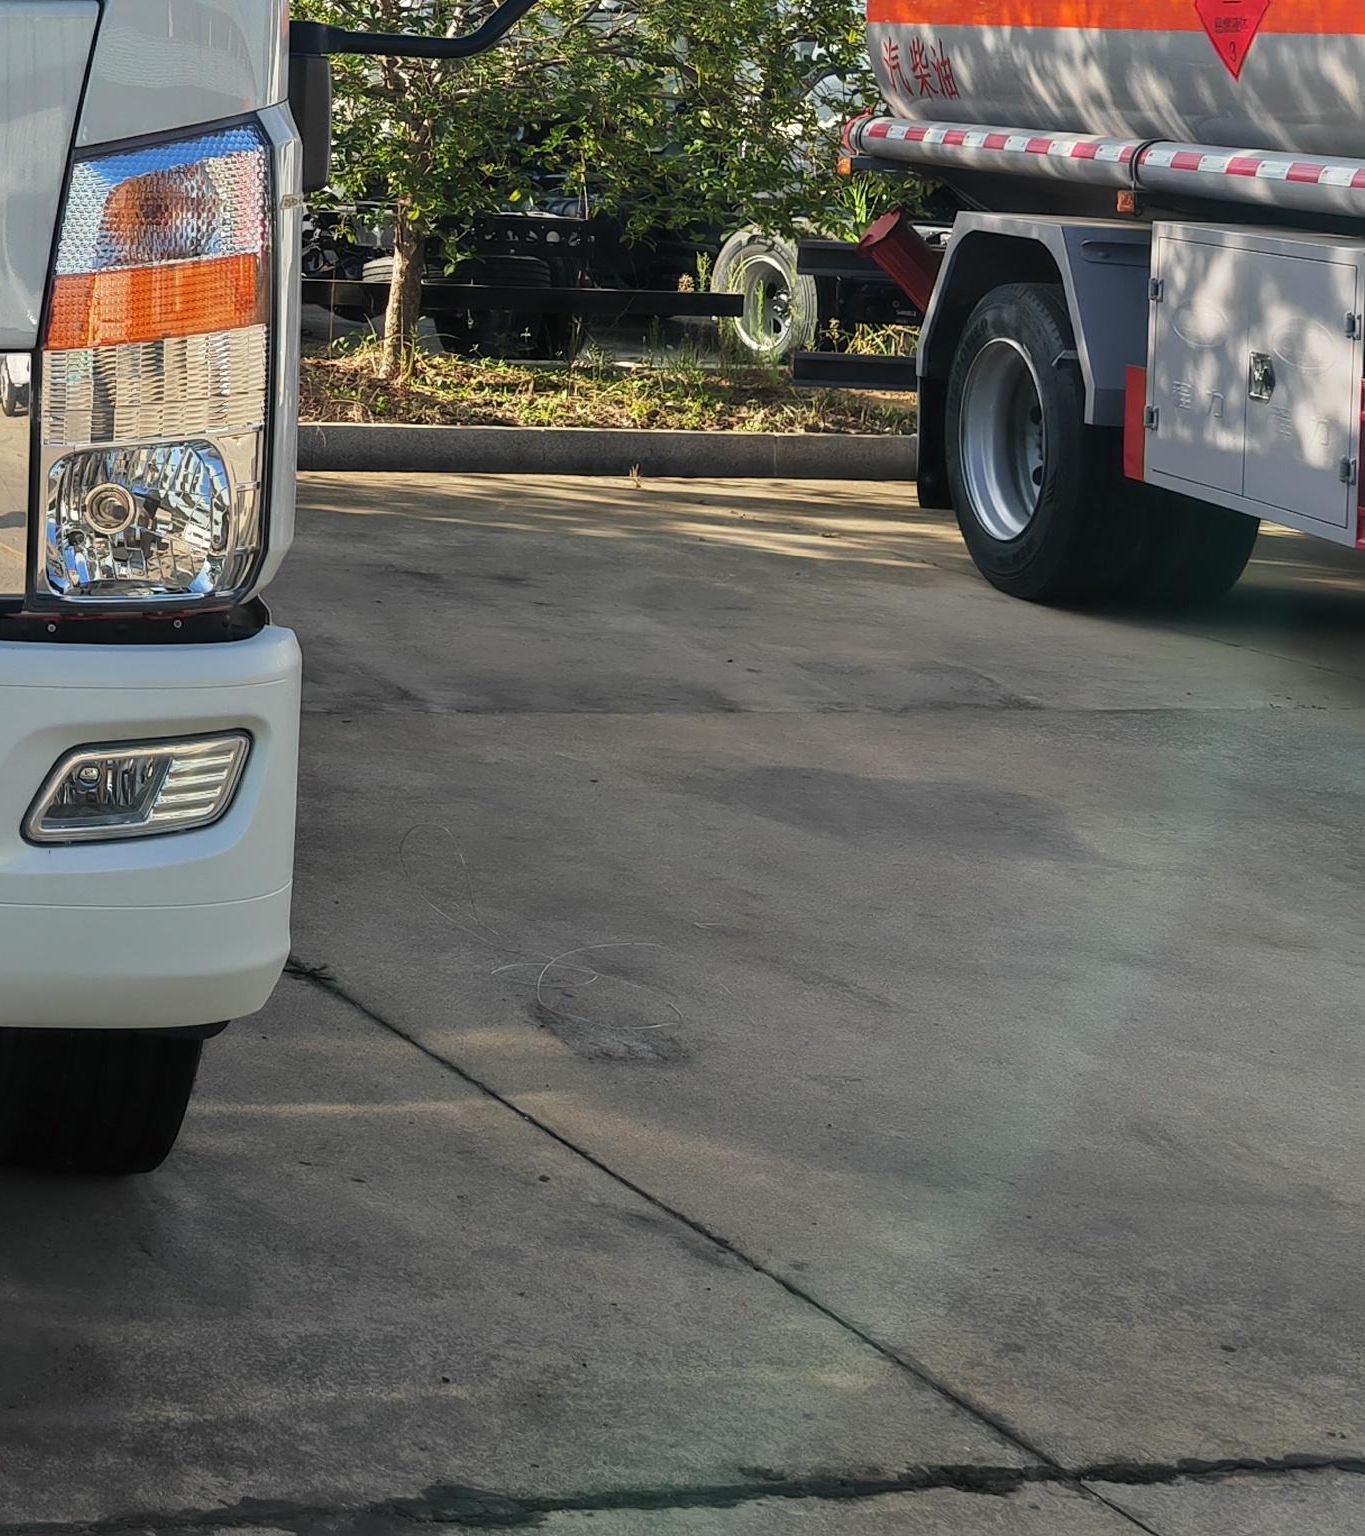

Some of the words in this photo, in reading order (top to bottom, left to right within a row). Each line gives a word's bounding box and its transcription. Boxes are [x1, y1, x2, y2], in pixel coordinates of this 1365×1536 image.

[883, 36, 961, 104] 汽柴油
[1229, 41, 1237, 62] 3
